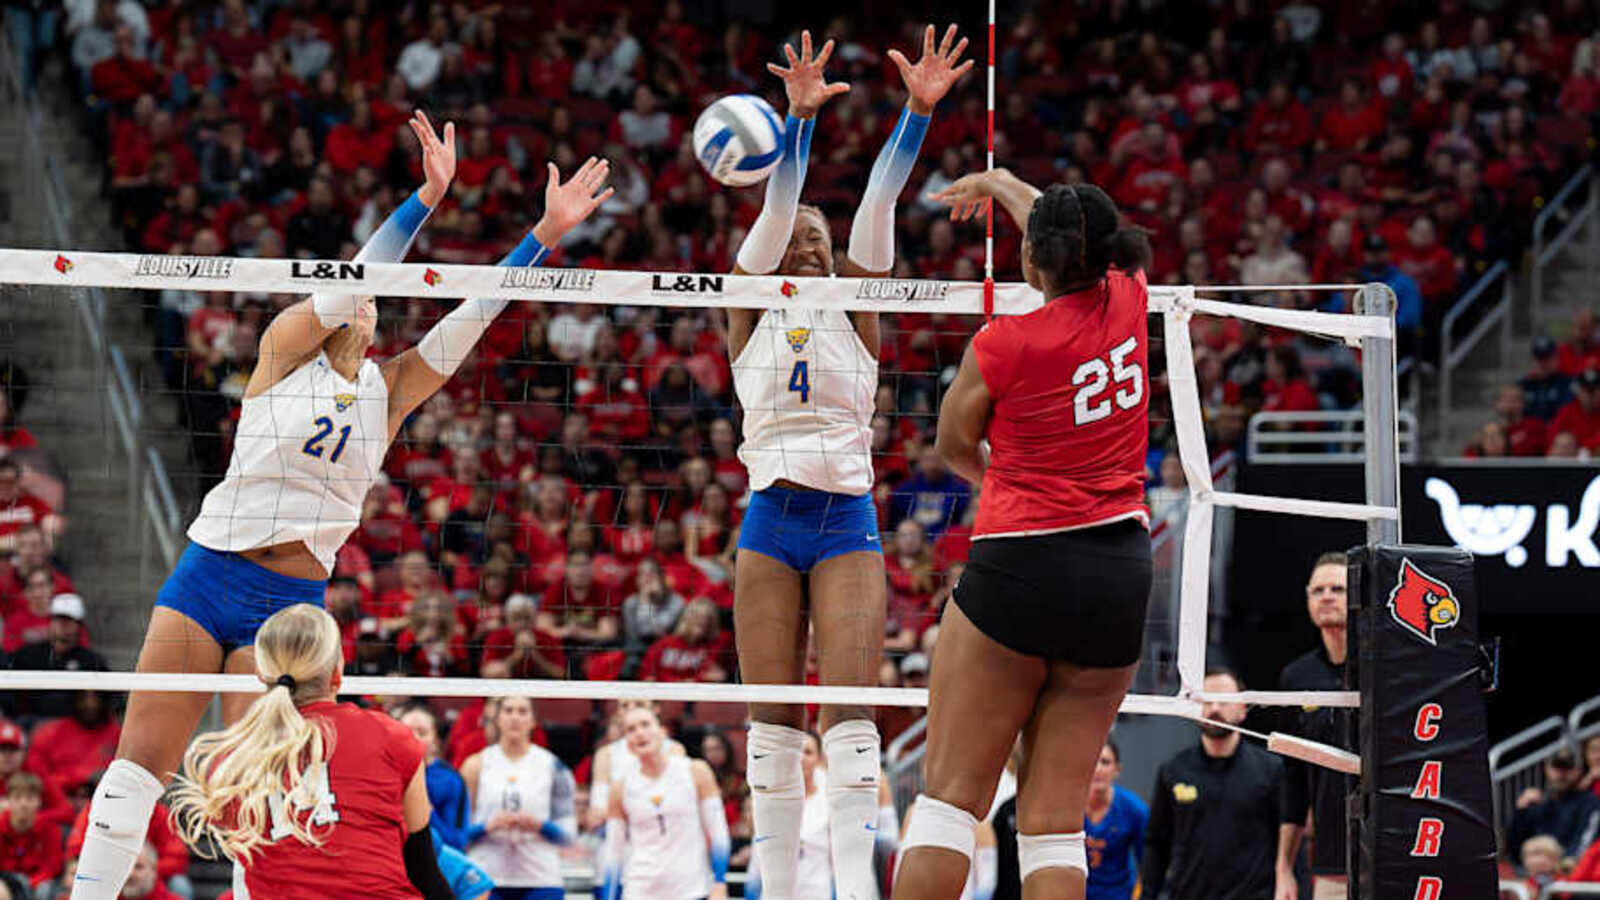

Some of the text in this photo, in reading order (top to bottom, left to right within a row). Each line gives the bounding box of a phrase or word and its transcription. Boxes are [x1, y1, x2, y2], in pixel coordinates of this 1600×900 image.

[135, 254, 233, 279] LOUISVILLE
[292, 262, 364, 280] L&N
[500, 266, 596, 291] LOUISVILLE
[652, 274, 723, 292] L&N
[856, 279, 949, 302] LOUISVILLE
[786, 359, 811, 405] 4
[1071, 335, 1144, 427] 25
[302, 416, 353, 464] 21
